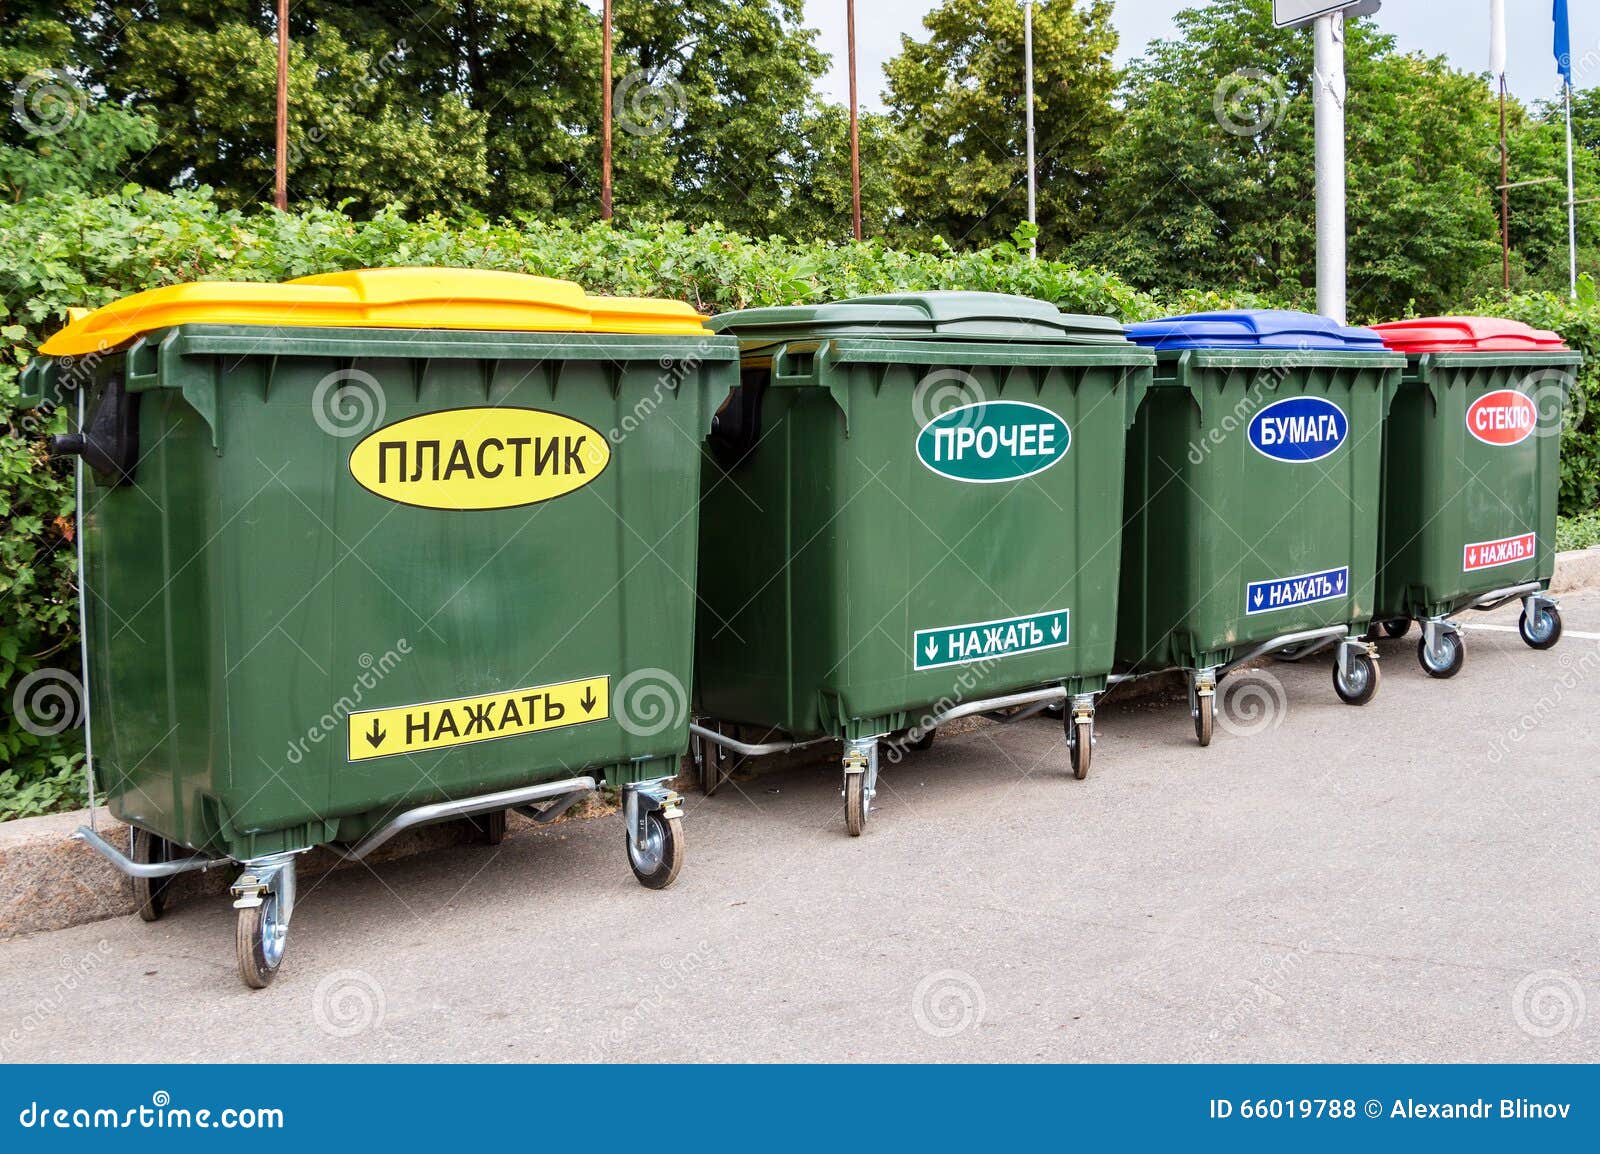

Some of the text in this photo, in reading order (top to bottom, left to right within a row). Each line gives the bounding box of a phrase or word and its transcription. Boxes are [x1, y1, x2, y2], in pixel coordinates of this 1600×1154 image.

[1261, 415, 1338, 445] БУМАГА
[1476, 406, 1530, 431] СТЕКЛО
[934, 423, 1055, 462] ПРОЧЕЕ
[378, 436, 587, 484] ПЛАСТИК
[1480, 540, 1524, 564] НАЖАТЬ
[1269, 576, 1332, 606] НАЖАТЬ
[948, 621, 1044, 659] НАЖАТЬ
[405, 693, 566, 745] НАЖАТЬ
